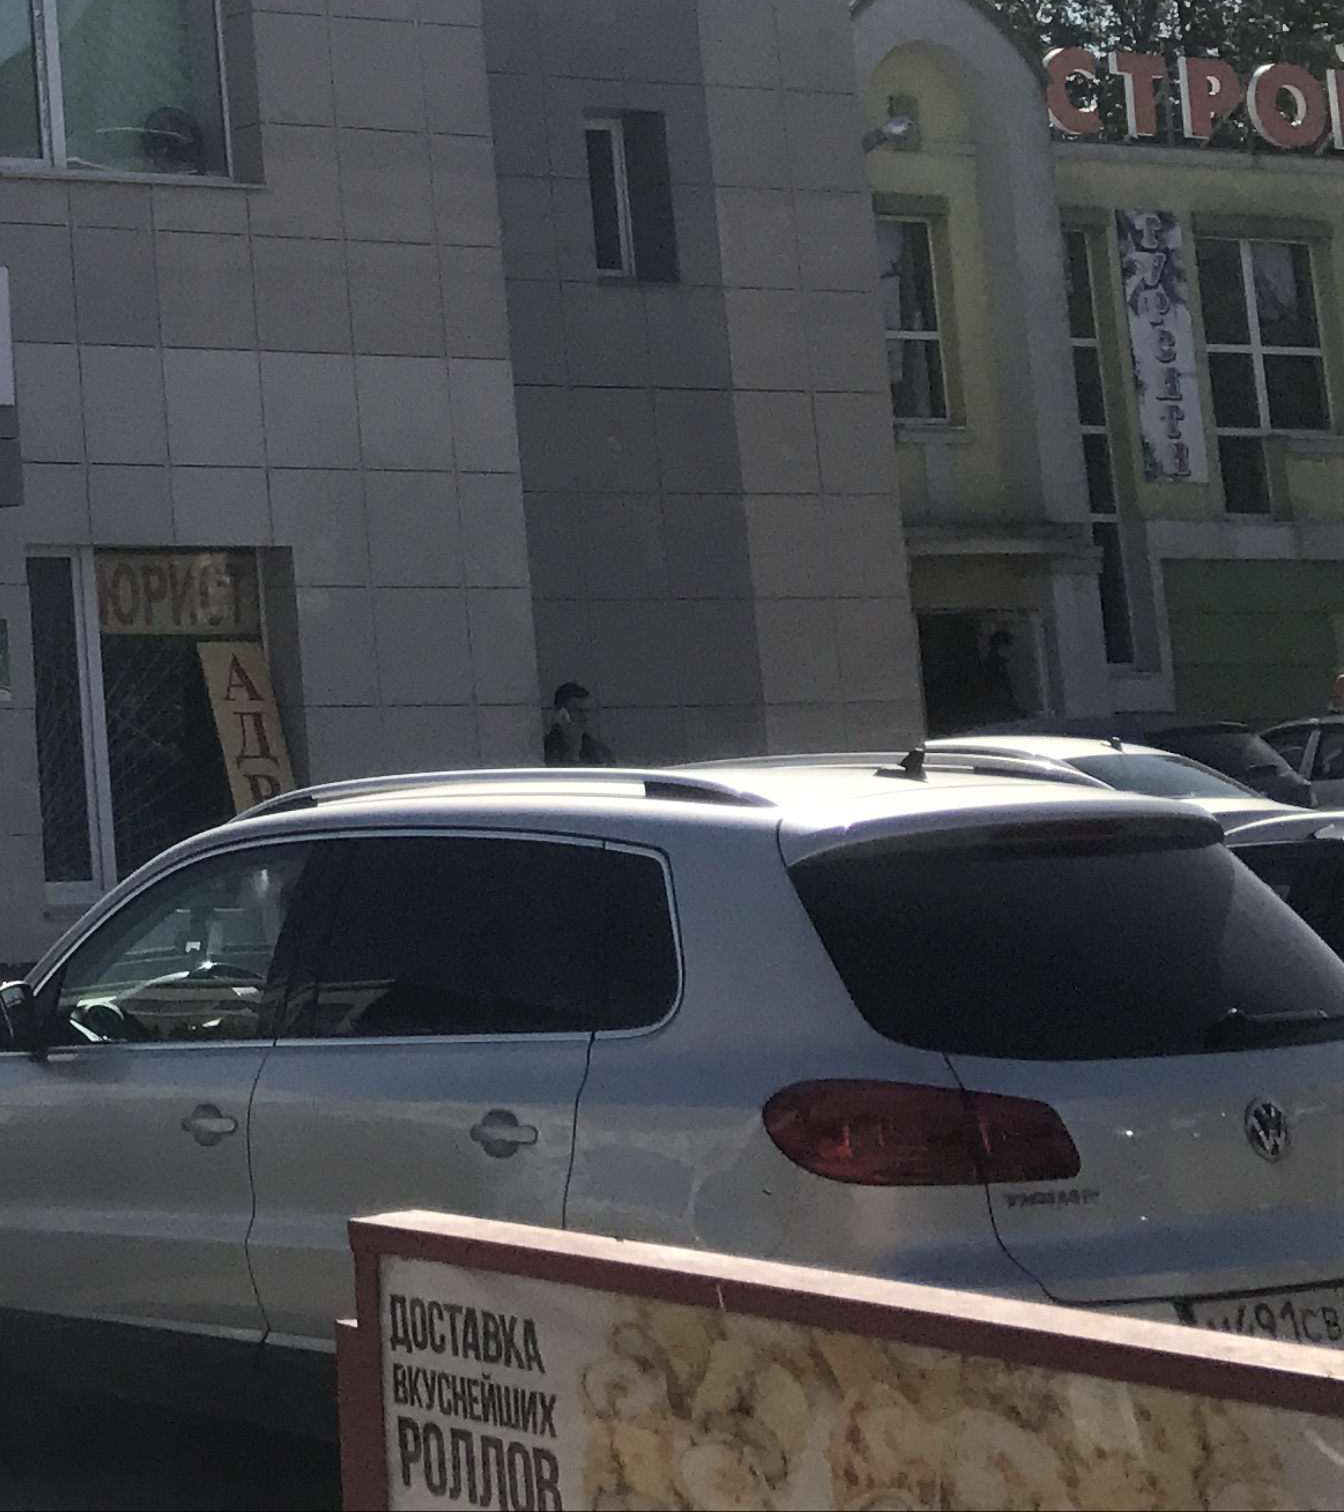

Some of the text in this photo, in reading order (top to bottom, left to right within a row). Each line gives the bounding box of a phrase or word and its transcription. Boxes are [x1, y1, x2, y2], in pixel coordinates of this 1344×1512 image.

[1042, 44, 1344, 151] СТРО
[97, 563, 244, 626] ЮРИСТ
[389, 1294, 545, 1375] ДОСТАВКА
[392, 1360, 557, 1439] ВКУСНЕЙШИХ
[397, 1416, 561, 1512] РОЛЛОВ
